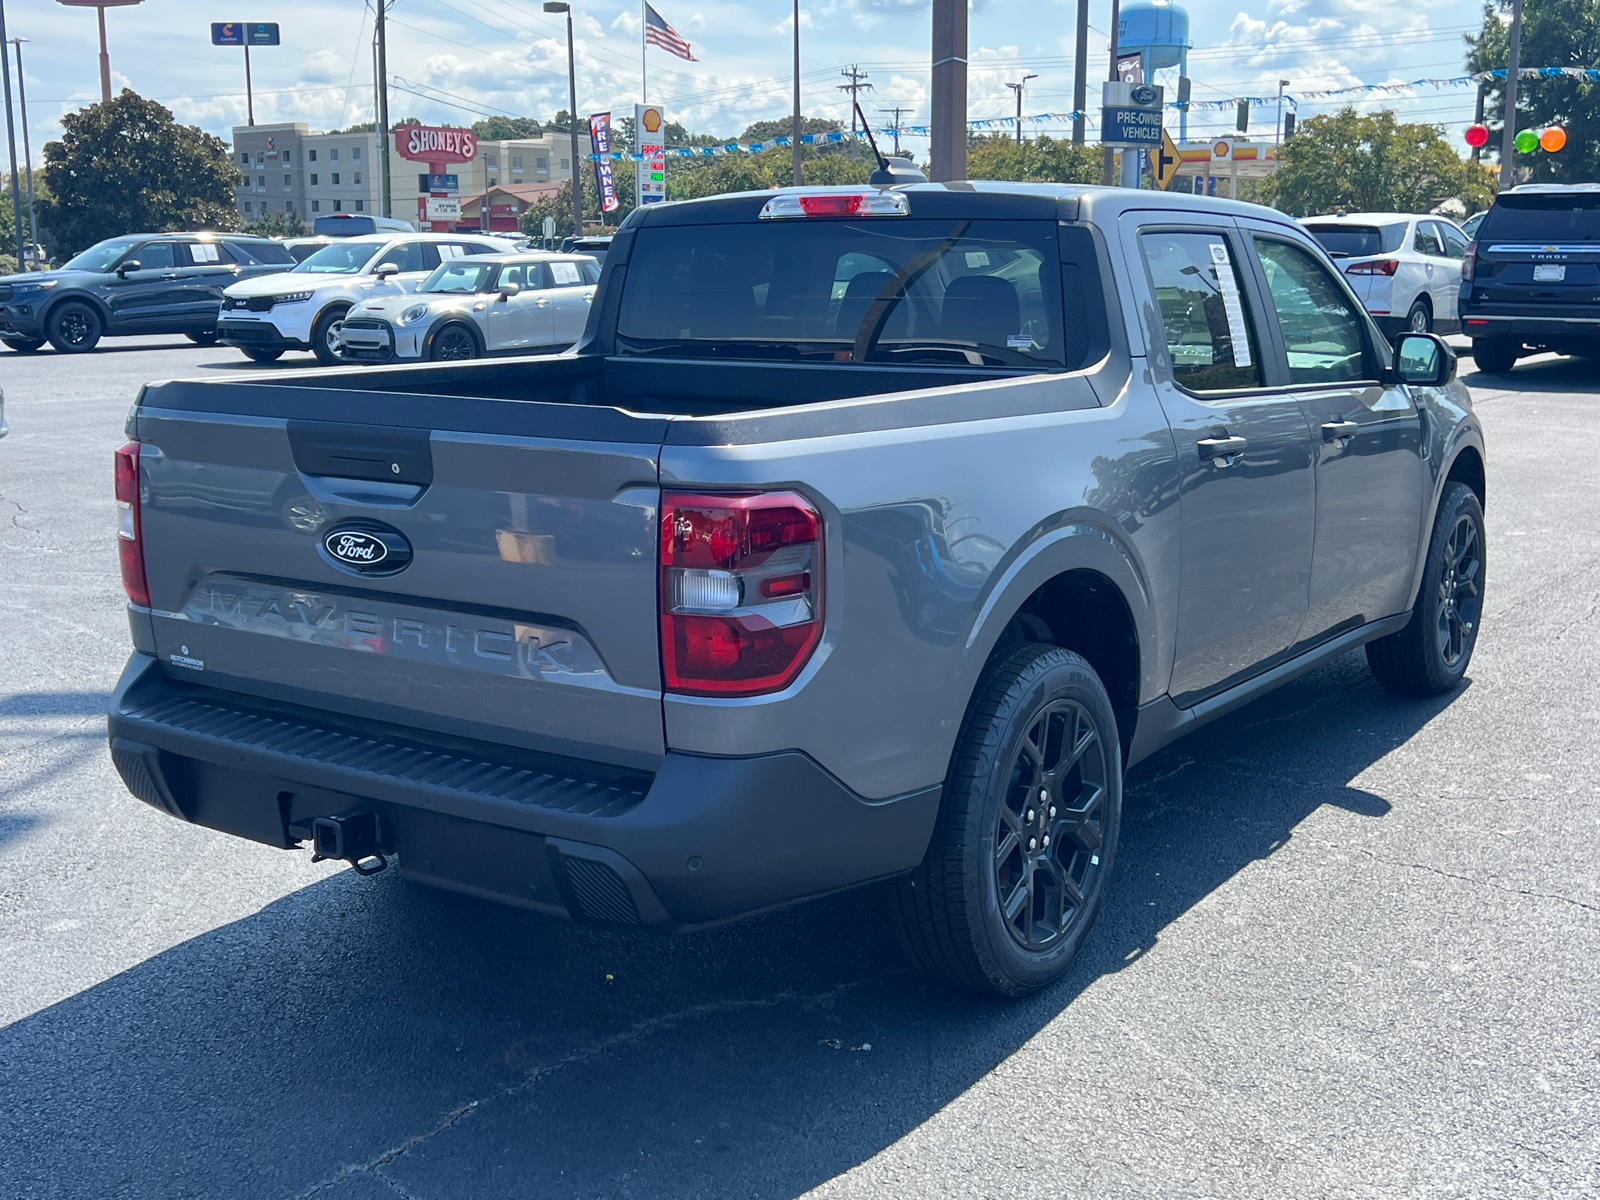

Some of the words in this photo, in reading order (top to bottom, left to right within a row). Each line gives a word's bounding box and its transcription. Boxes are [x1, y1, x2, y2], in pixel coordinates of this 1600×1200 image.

[408, 129, 475, 158] SHONEY'S
[596, 121, 608, 152] PRE
[1122, 126, 1160, 140] VEHICLES
[336, 535, 376, 560] Ford
[210, 589, 573, 672] MAVERICK
[170, 654, 204, 666] HUTCHINSON
